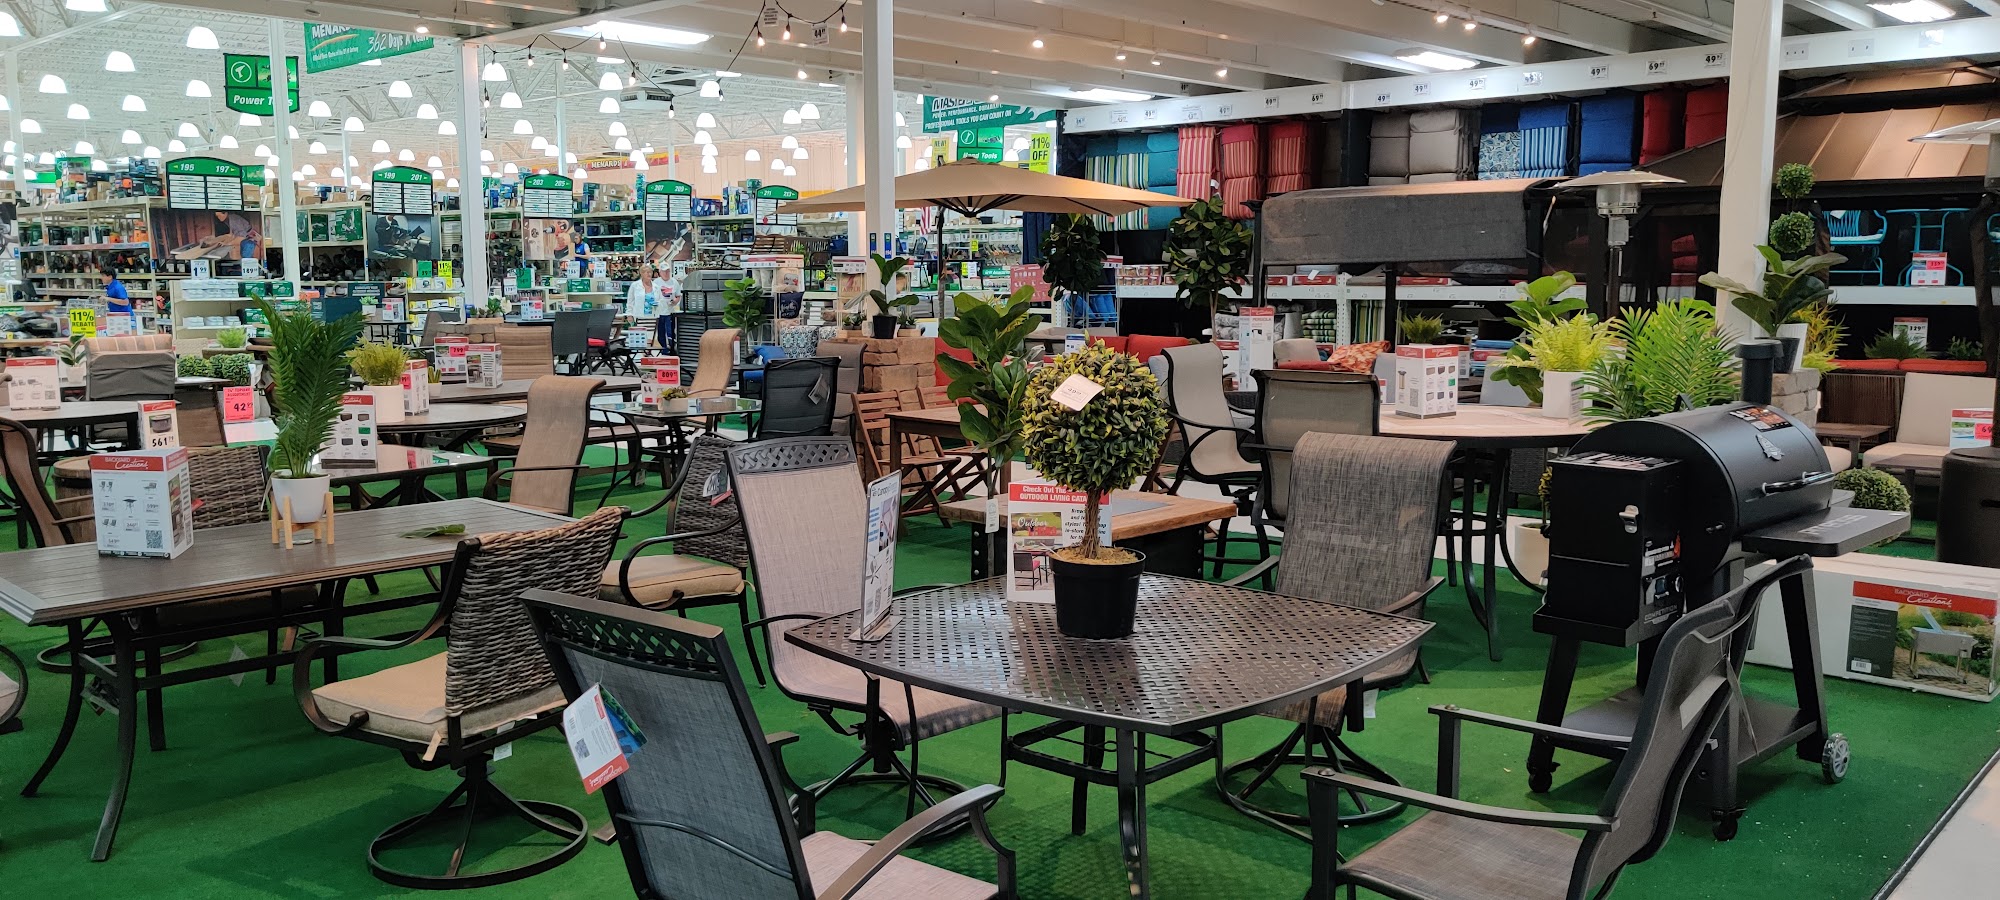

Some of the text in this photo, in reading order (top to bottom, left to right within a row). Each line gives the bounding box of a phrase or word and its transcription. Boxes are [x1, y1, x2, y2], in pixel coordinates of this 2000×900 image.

[388, 32, 404, 51] Days
[233, 94, 265, 105] Power
[956, 116, 970, 126] TOOLS
[988, 110, 1005, 119] COUNT
[1031, 136, 1050, 149] 11%
[981, 152, 998, 160] Tools
[1032, 150, 1048, 161] OFF
[180, 163, 230, 173] 195 197
[384, 172, 423, 181] 199 201
[71, 310, 95, 322] 11%
[114, 458, 149, 470] Creations
[1022, 485, 1042, 493] Check
[1019, 493, 1049, 501] OUTDOOR
[1894, 588, 1930, 599] BACKYARD
[1906, 594, 1953, 607] Creations
[1644, 604, 1678, 621] COMPETITION
